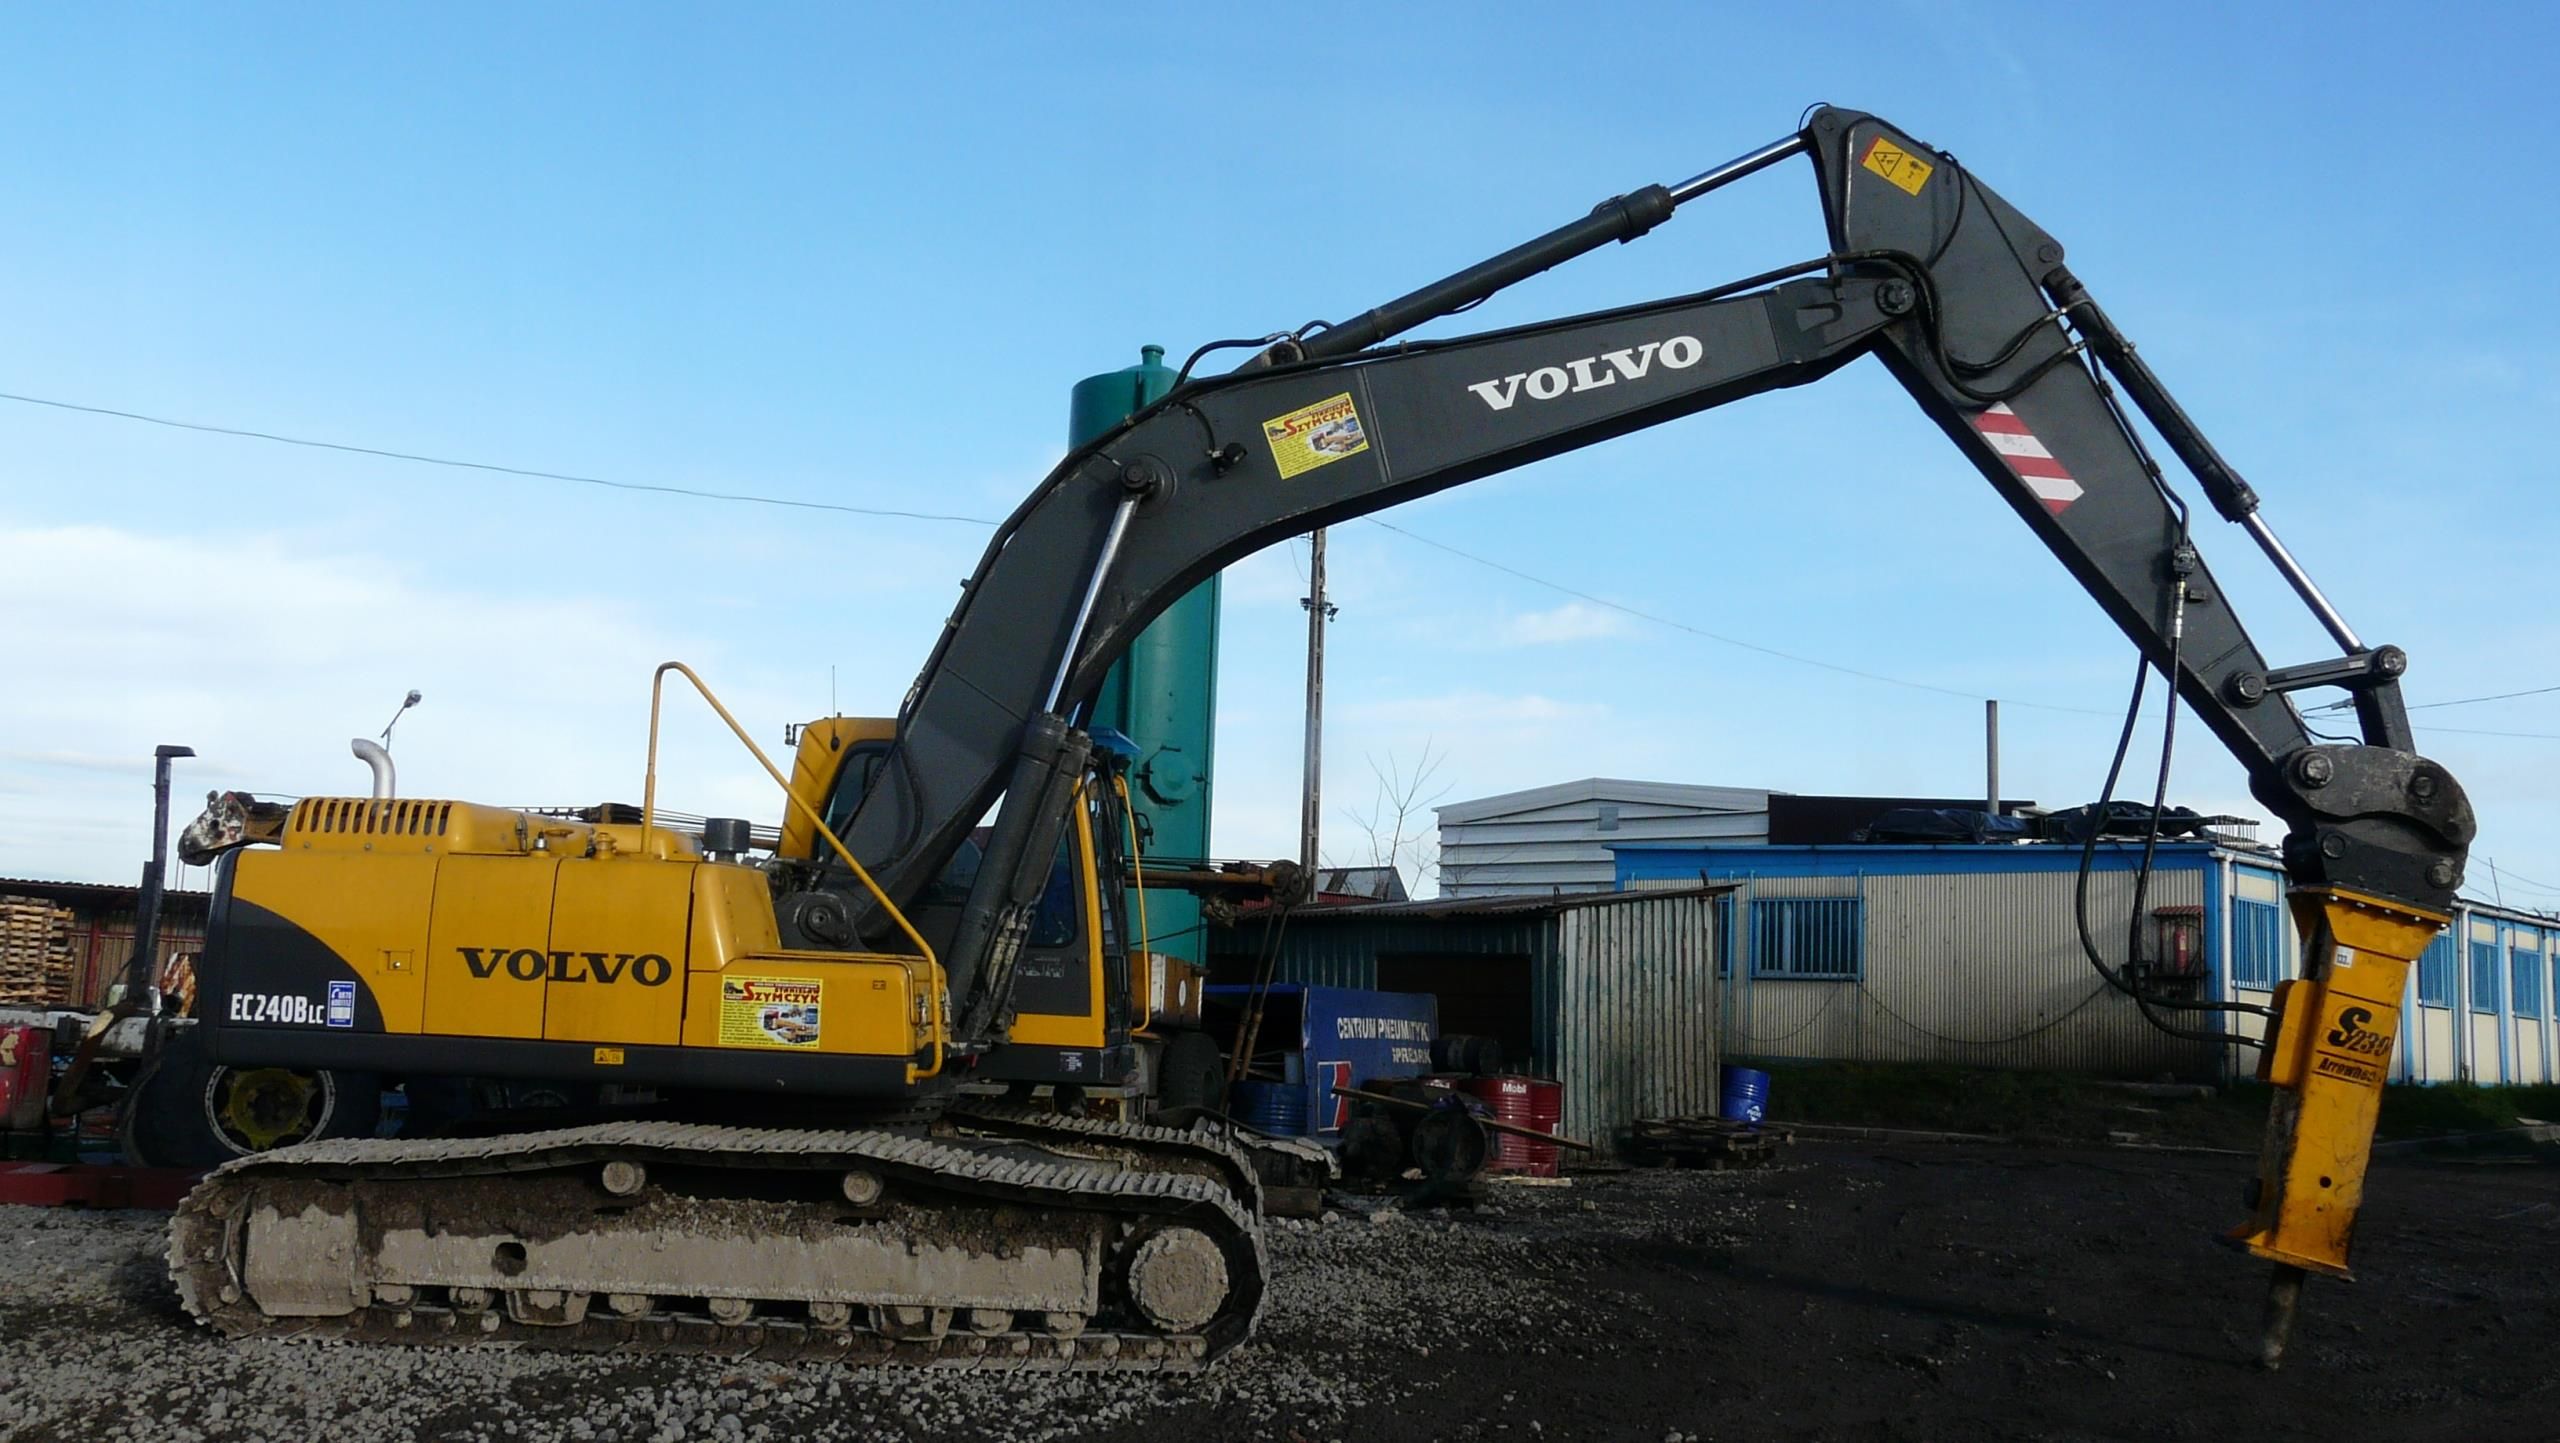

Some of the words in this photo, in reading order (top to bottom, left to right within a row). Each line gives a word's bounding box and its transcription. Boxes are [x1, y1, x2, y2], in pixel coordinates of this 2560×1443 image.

[1467, 335, 1703, 411] VOLVO
[1283, 405, 1353, 436] SZYMCZYK
[456, 947, 672, 986] VOLVO
[743, 981, 819, 1004] SZYMCZYK
[1337, 1017, 1376, 1039] CENTRUM
[1502, 1082, 1527, 1094] Mobil
